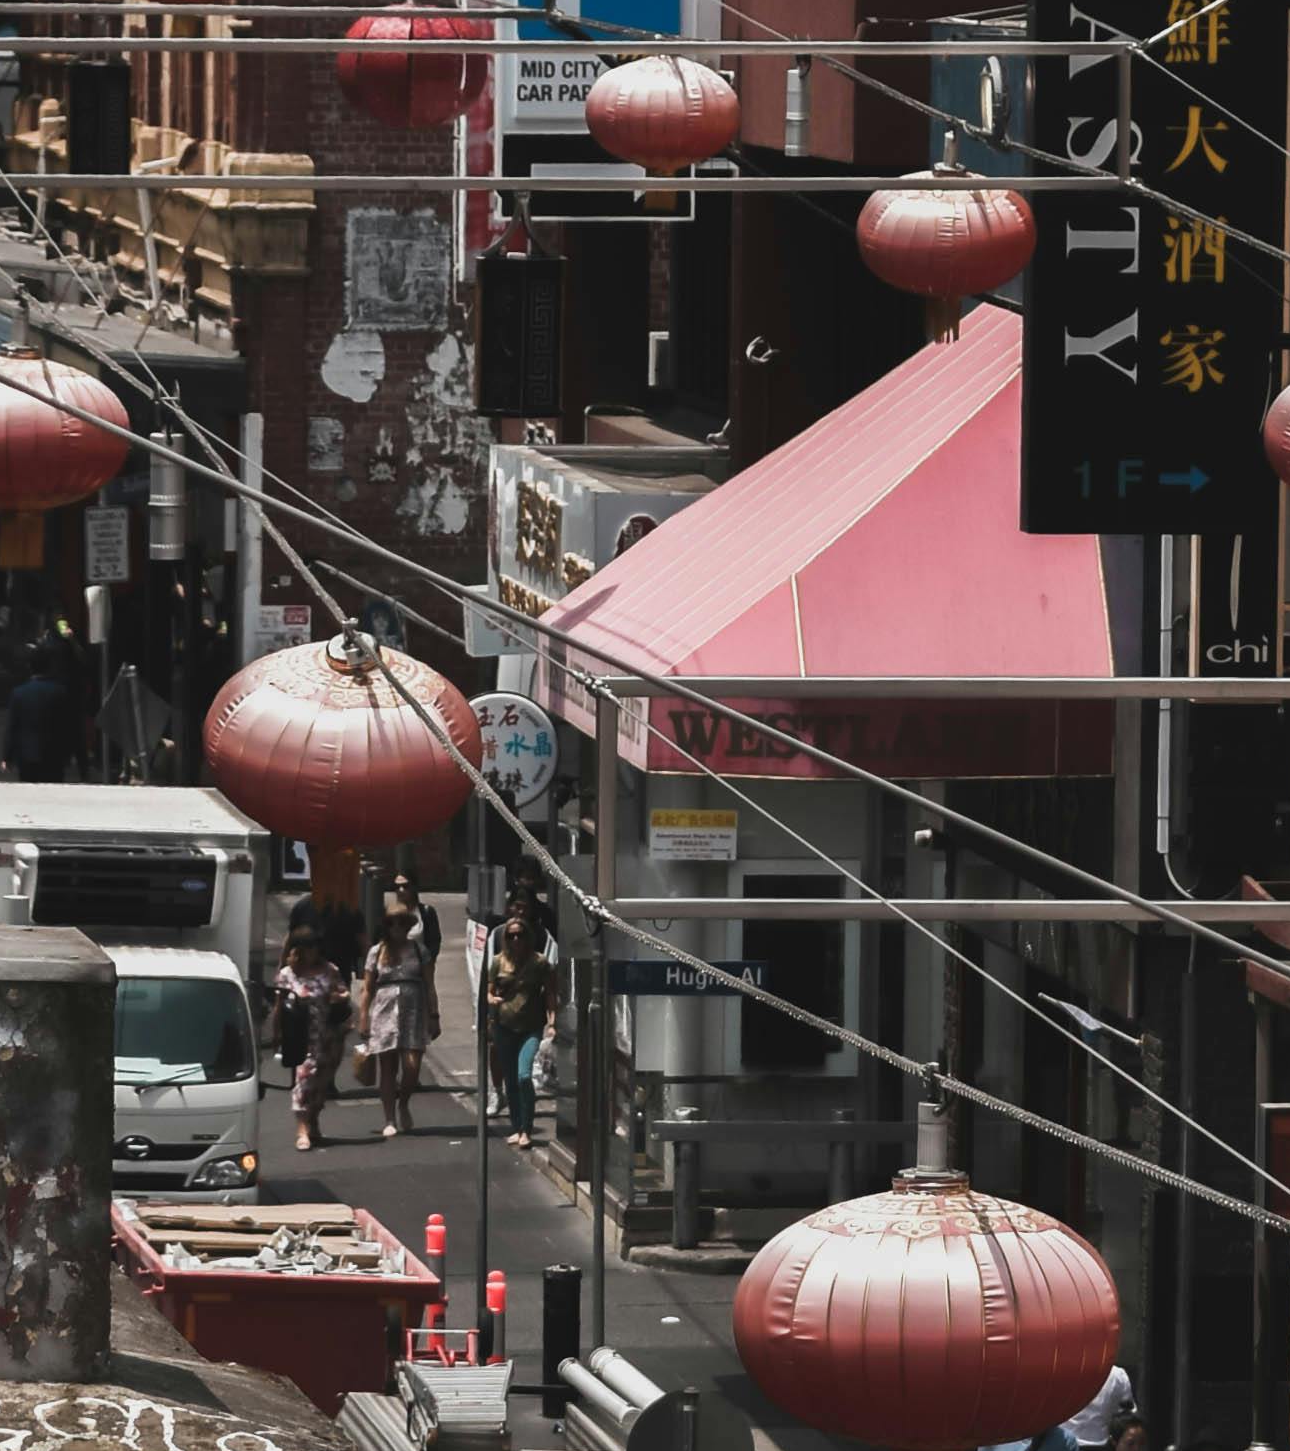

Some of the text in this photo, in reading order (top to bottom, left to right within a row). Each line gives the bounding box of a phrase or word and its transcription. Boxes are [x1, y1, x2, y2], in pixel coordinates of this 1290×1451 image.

[520, 60, 602, 79] MID CITY
[516, 83, 591, 102] CAR PAR
[740, 966, 762, 986] Al
